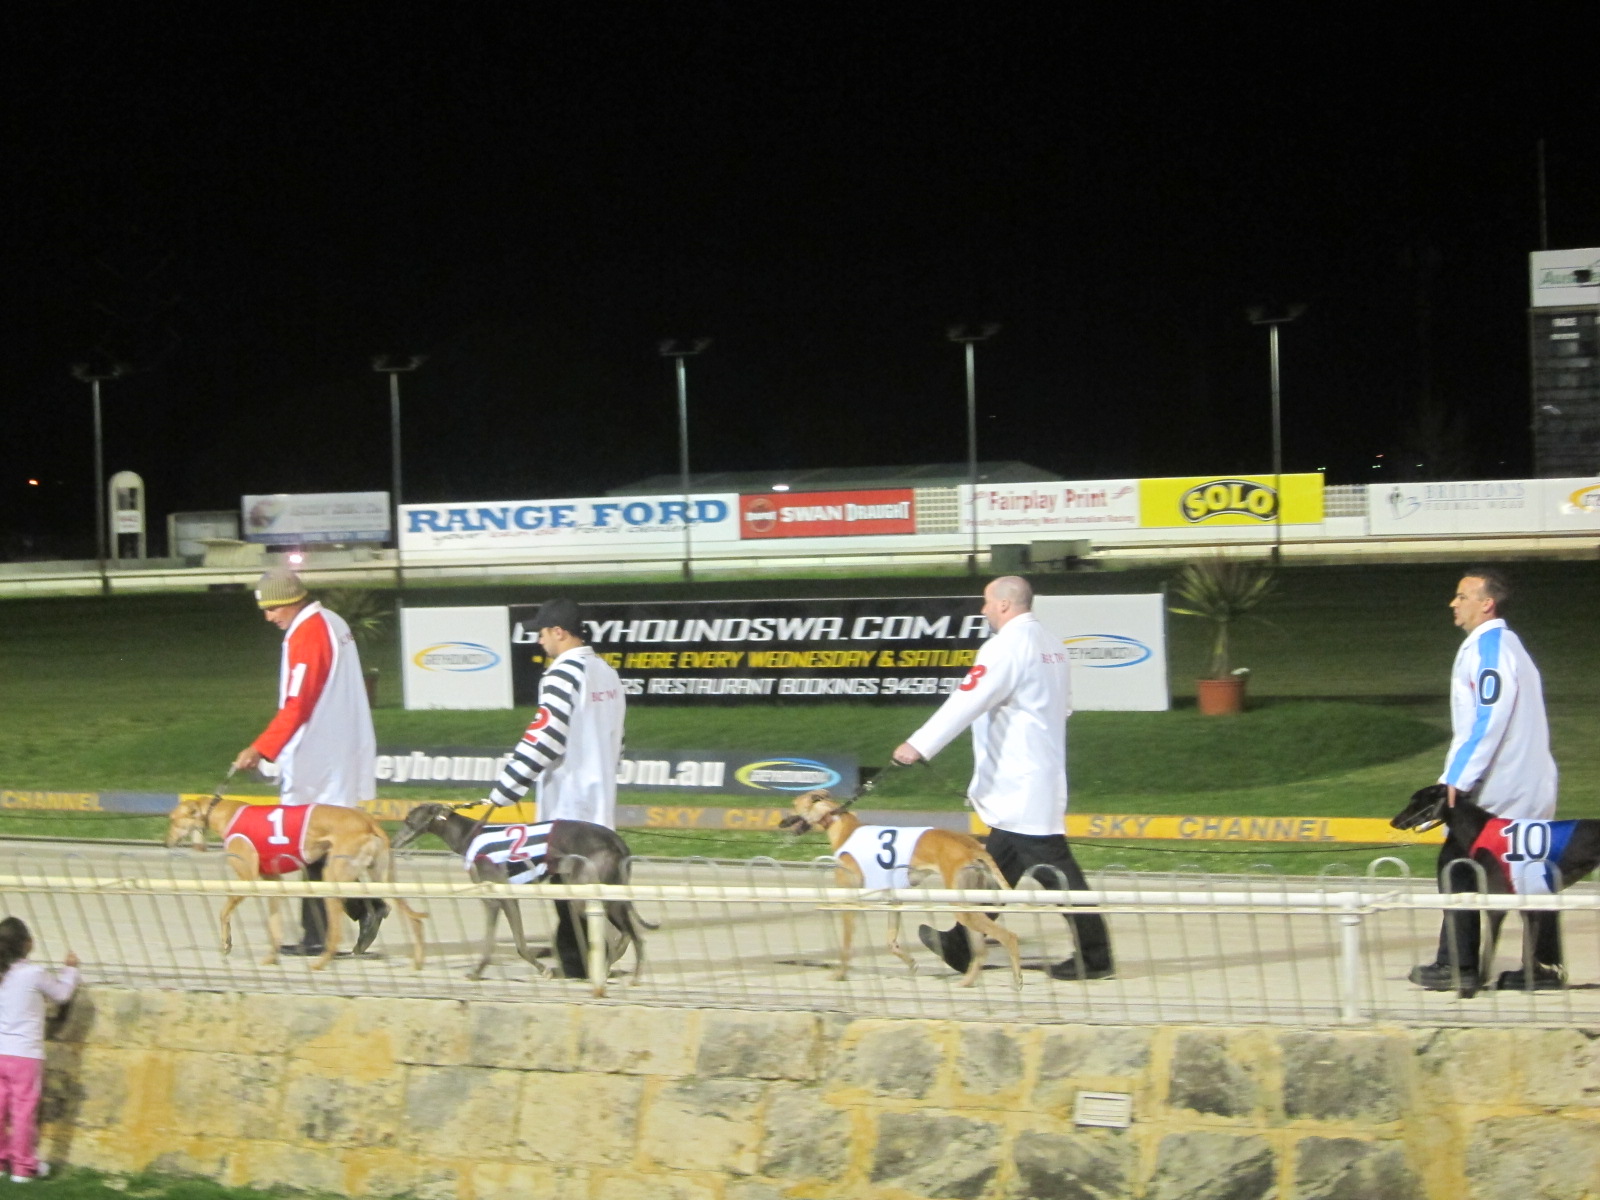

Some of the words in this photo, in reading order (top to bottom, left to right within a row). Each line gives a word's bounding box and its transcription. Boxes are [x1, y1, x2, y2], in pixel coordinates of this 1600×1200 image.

[779, 505, 843, 523] SWAN
[988, 490, 1058, 514] Fairplay
[1063, 488, 1108, 509] Print
[1184, 484, 1276, 517] SOLO
[408, 505, 576, 533] RANGE
[591, 500, 728, 527] FORD
[624, 651, 678, 669] HERE
[677, 651, 745, 668] EVERY
[747, 650, 877, 668] WEDNESDAY
[876, 650, 895, 667] &
[899, 649, 978, 667] SATUR
[647, 678, 777, 695] RESTAURANT
[778, 677, 881, 695] BOOKINGS
[959, 664, 988, 692] 3
[521, 705, 553, 744] 2
[265, 807, 290, 845] 1
[646, 806, 705, 827] SKY
[1088, 814, 1152, 839] SKY
[1178, 816, 1336, 842] CHANNEL
[503, 824, 532, 863] 2
[876, 828, 899, 870] 3
[1501, 821, 1551, 863] 10
